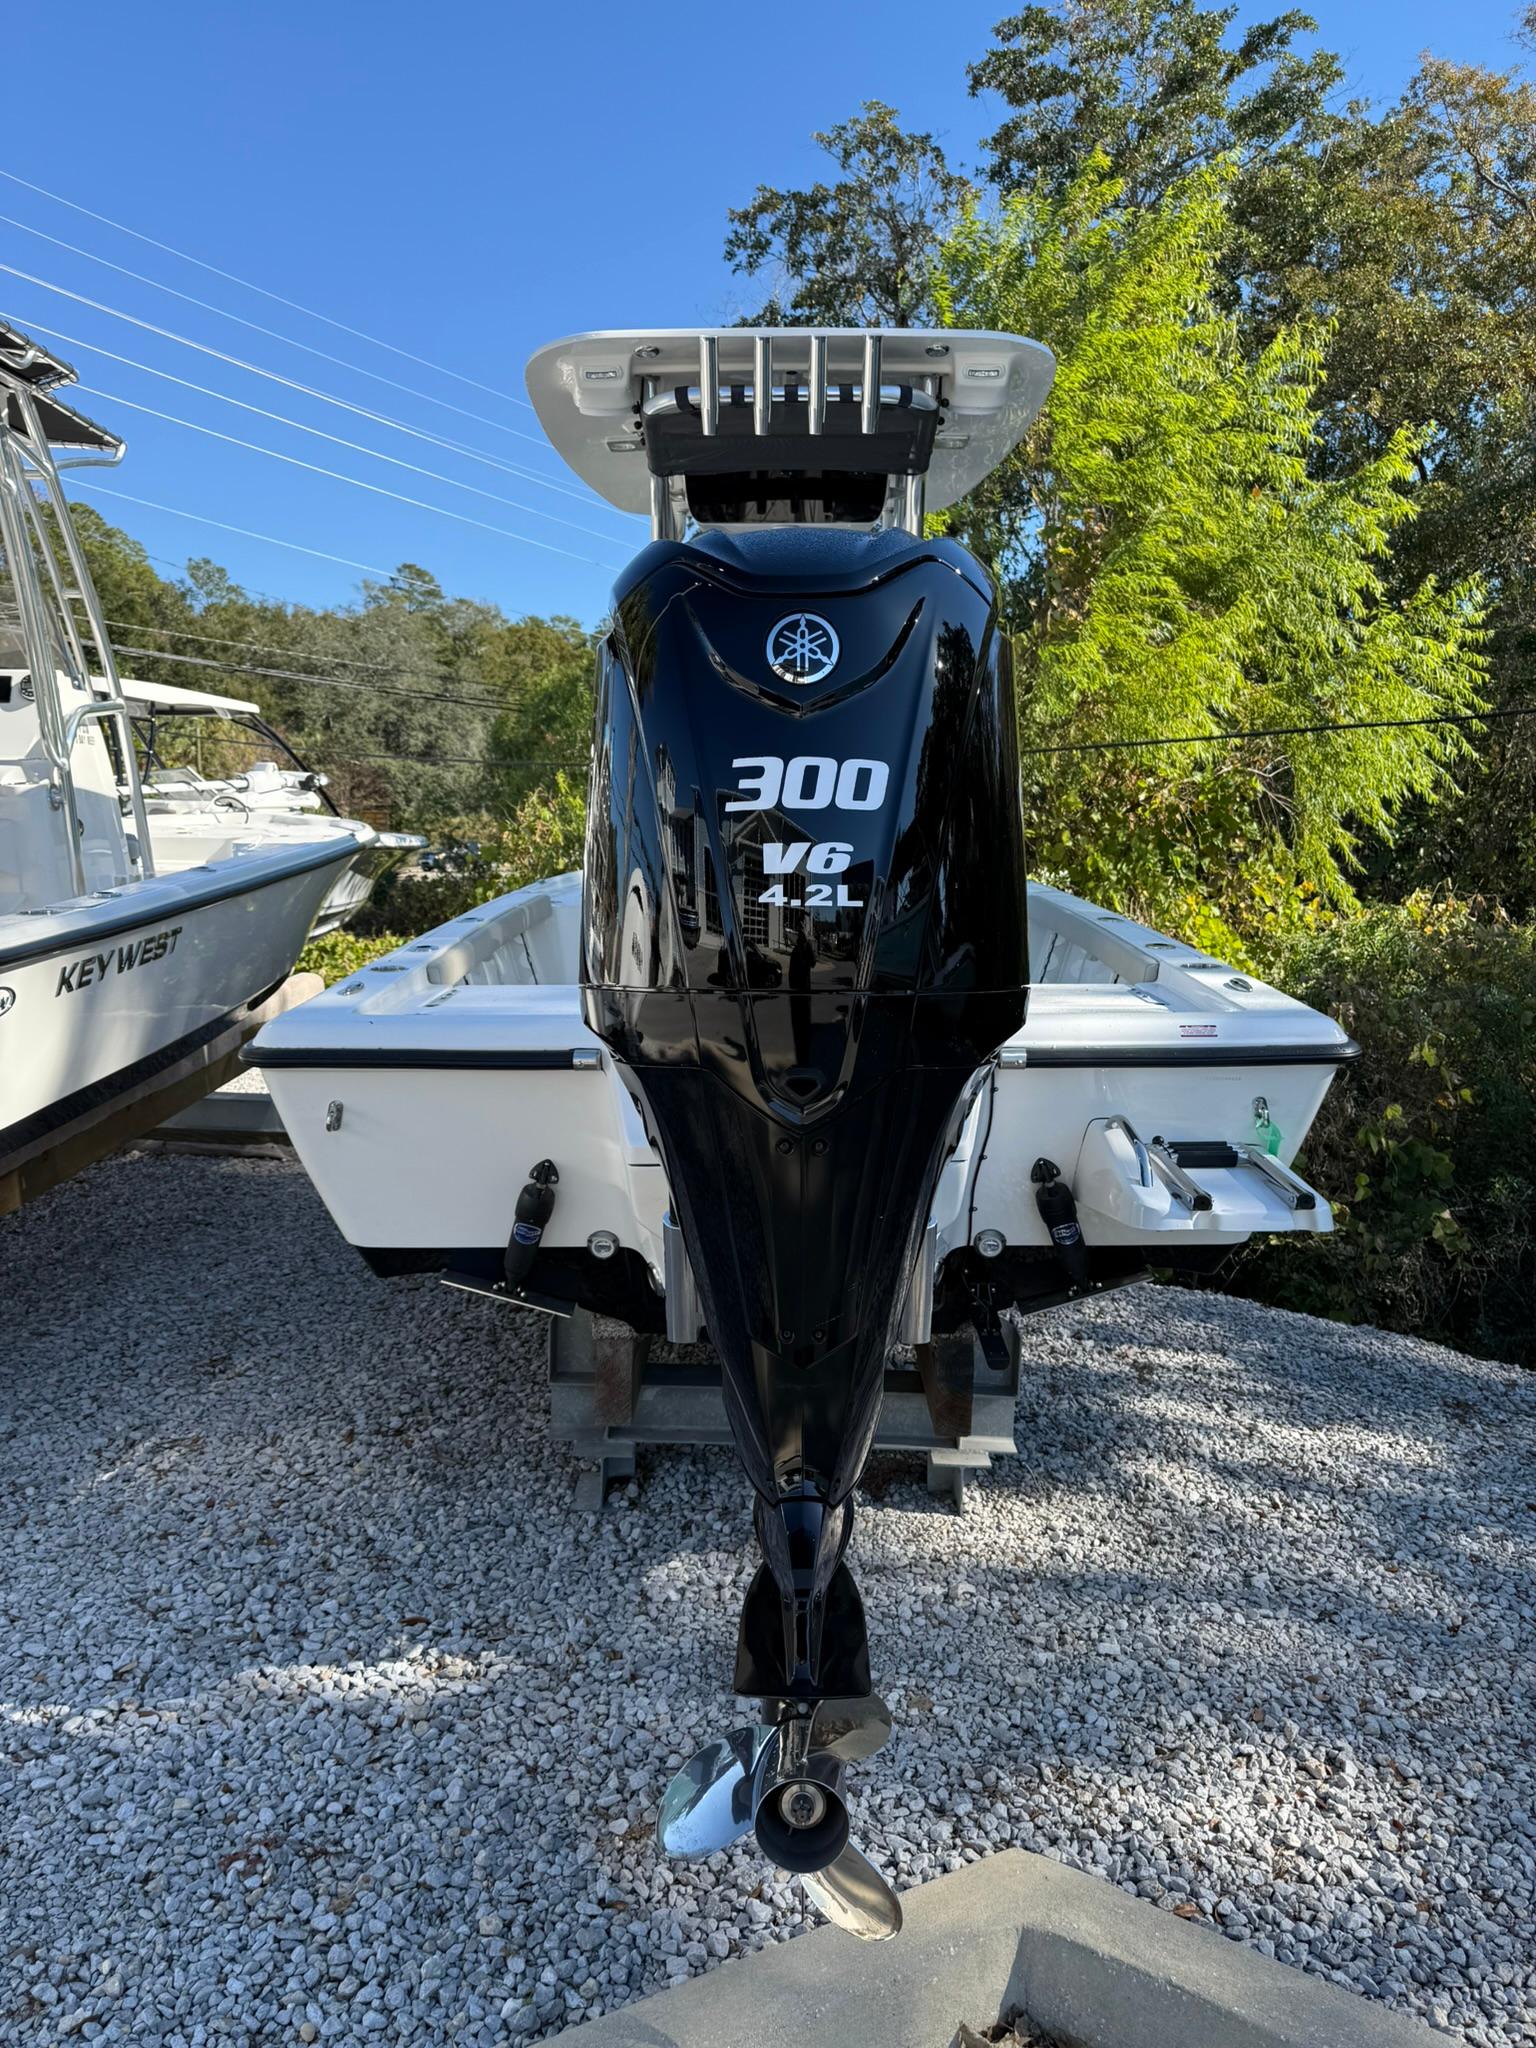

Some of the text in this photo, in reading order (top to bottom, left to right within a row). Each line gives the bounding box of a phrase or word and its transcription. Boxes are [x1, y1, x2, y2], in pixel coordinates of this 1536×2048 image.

[725, 756, 890, 812] 300
[763, 842, 854, 874] V6
[758, 884, 864, 907] 4.2L
